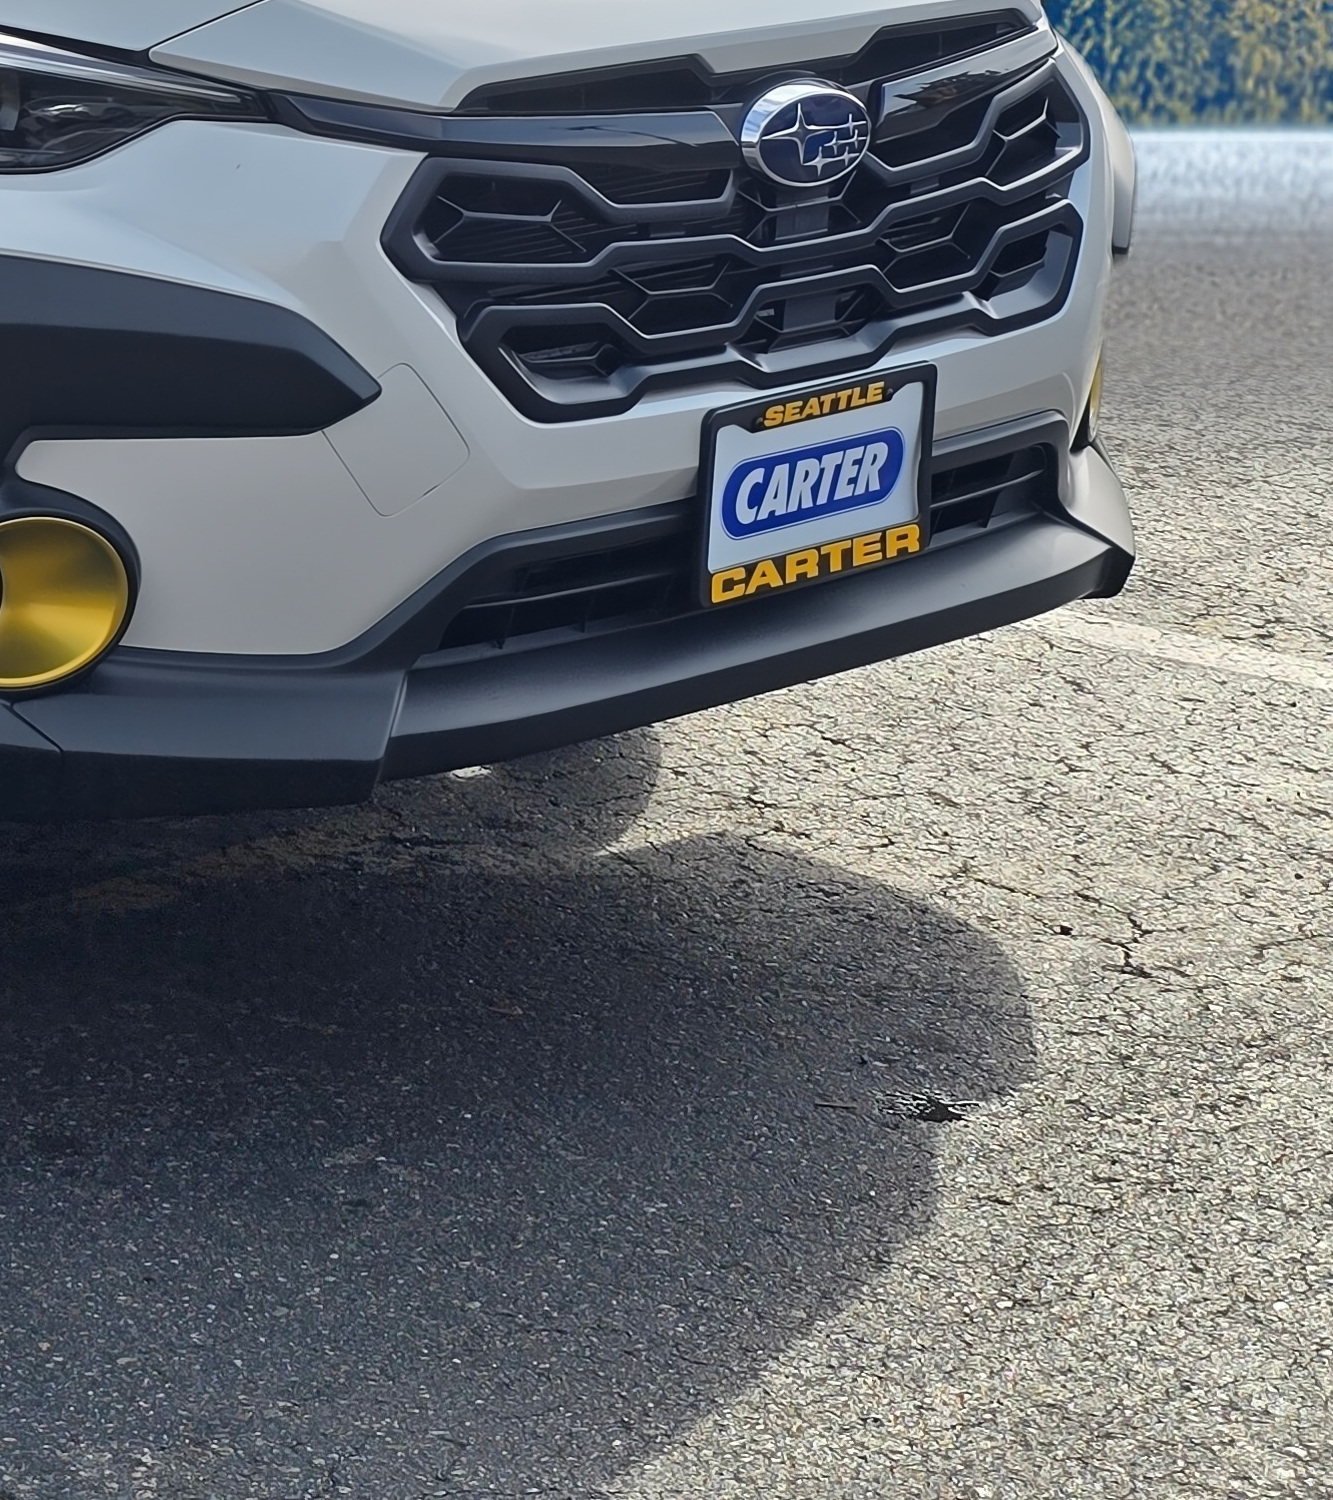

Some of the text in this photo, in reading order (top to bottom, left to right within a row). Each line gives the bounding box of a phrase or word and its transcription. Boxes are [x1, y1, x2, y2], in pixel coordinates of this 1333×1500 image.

[763, 381, 885, 428] SEATTLE
[735, 441, 889, 525] CARTER
[711, 523, 921, 604] CARTER
